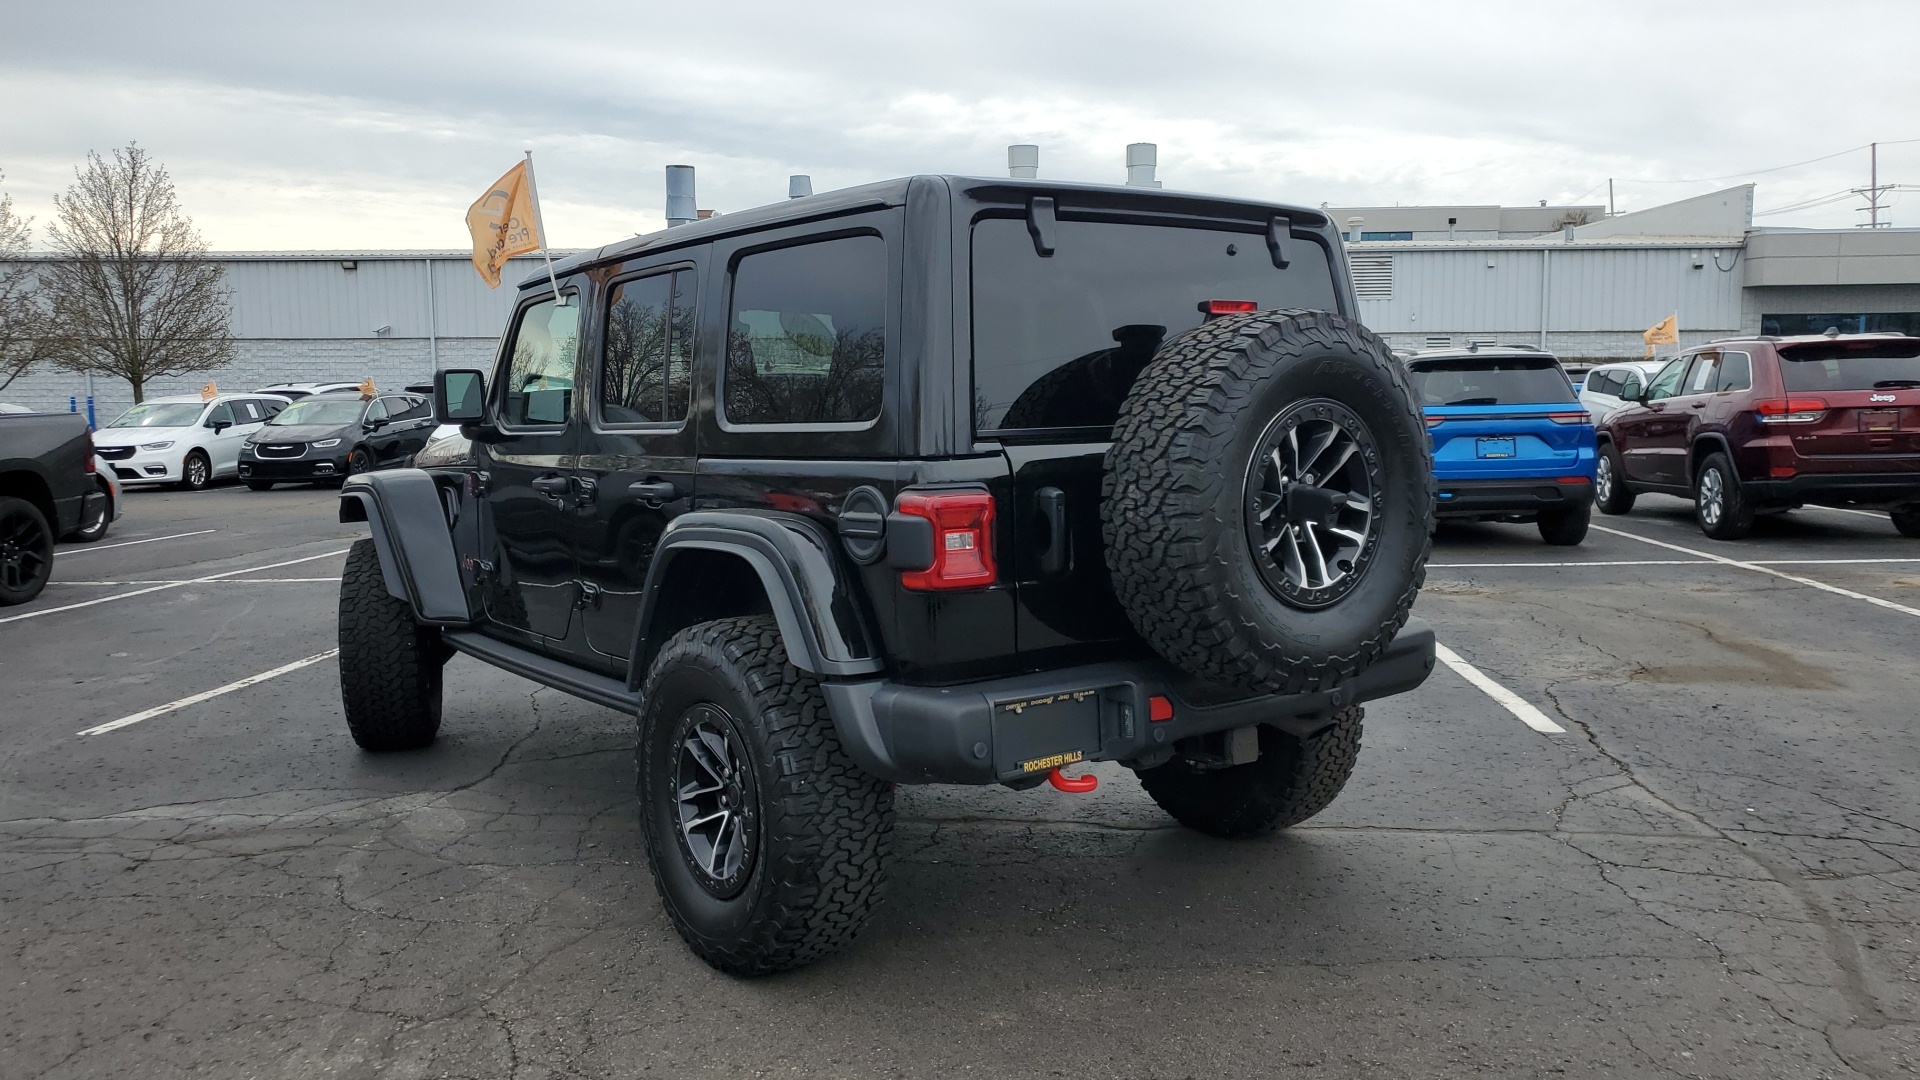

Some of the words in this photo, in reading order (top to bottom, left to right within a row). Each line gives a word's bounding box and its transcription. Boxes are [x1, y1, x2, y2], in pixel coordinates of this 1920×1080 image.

[1869, 393, 1897, 403] Jeep
[1023, 754, 1064, 772] ROCHESTER
[1063, 750, 1083, 764] HILLS
